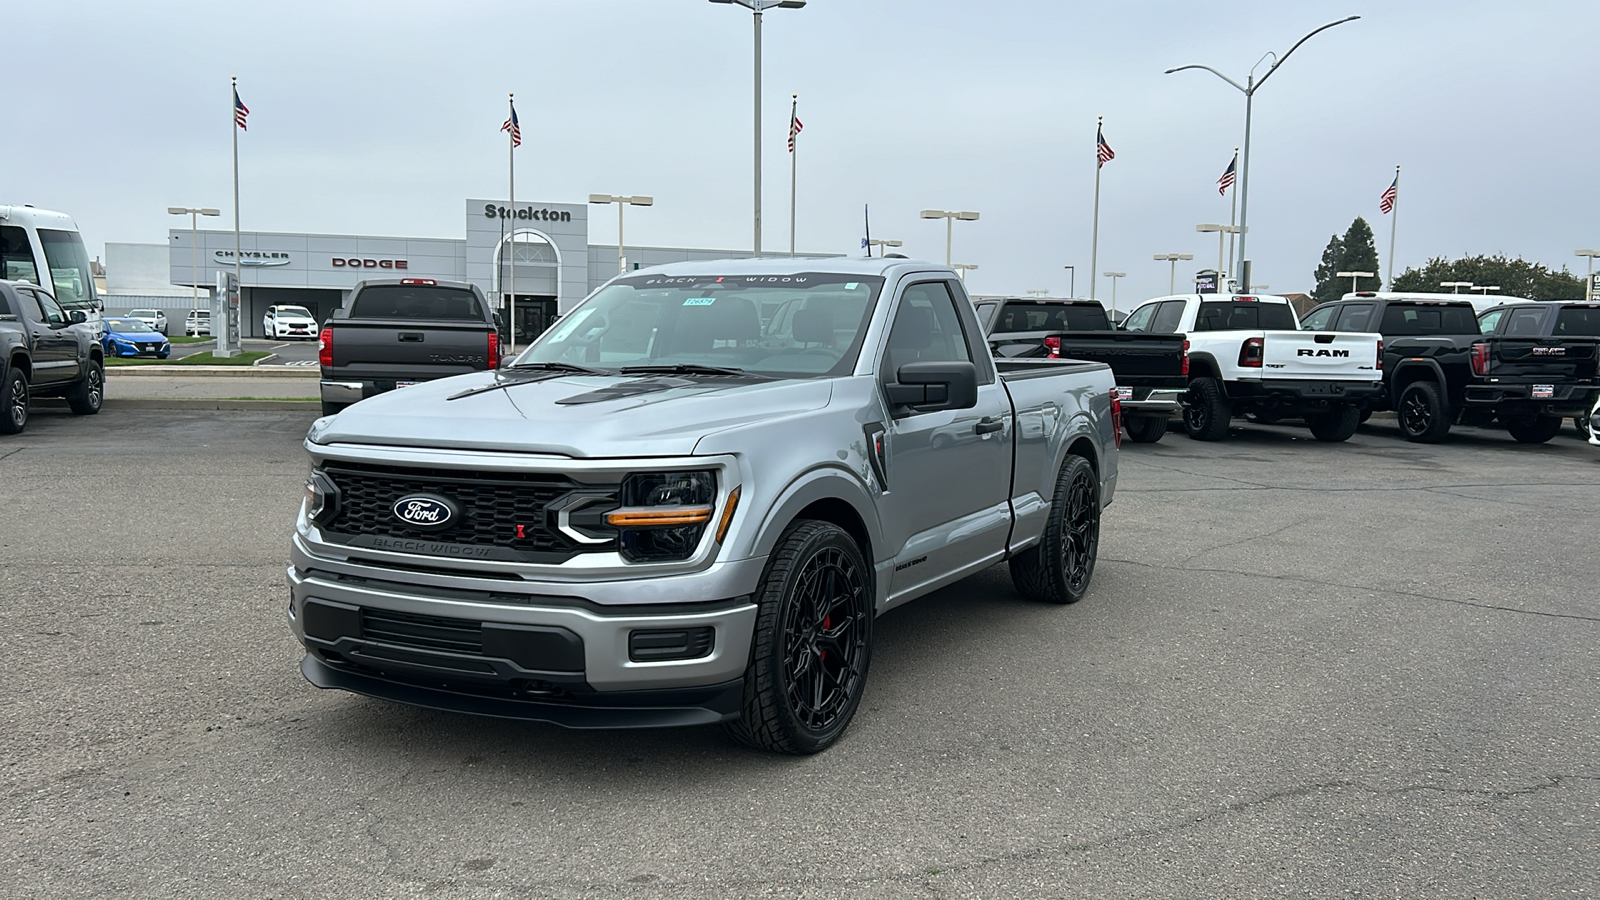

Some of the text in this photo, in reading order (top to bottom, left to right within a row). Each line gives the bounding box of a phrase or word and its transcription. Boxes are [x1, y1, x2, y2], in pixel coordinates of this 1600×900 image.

[484, 204, 571, 222] Stockton
[215, 250, 289, 259] CHRYSLER
[332, 257, 408, 269] DODGE
[1297, 349, 1350, 357] RAM
[1532, 347, 1566, 355] GMC
[430, 353, 484, 363] TUNDRA
[404, 501, 440, 522] Ford
[373, 538, 491, 557] BLACK WIDOW
